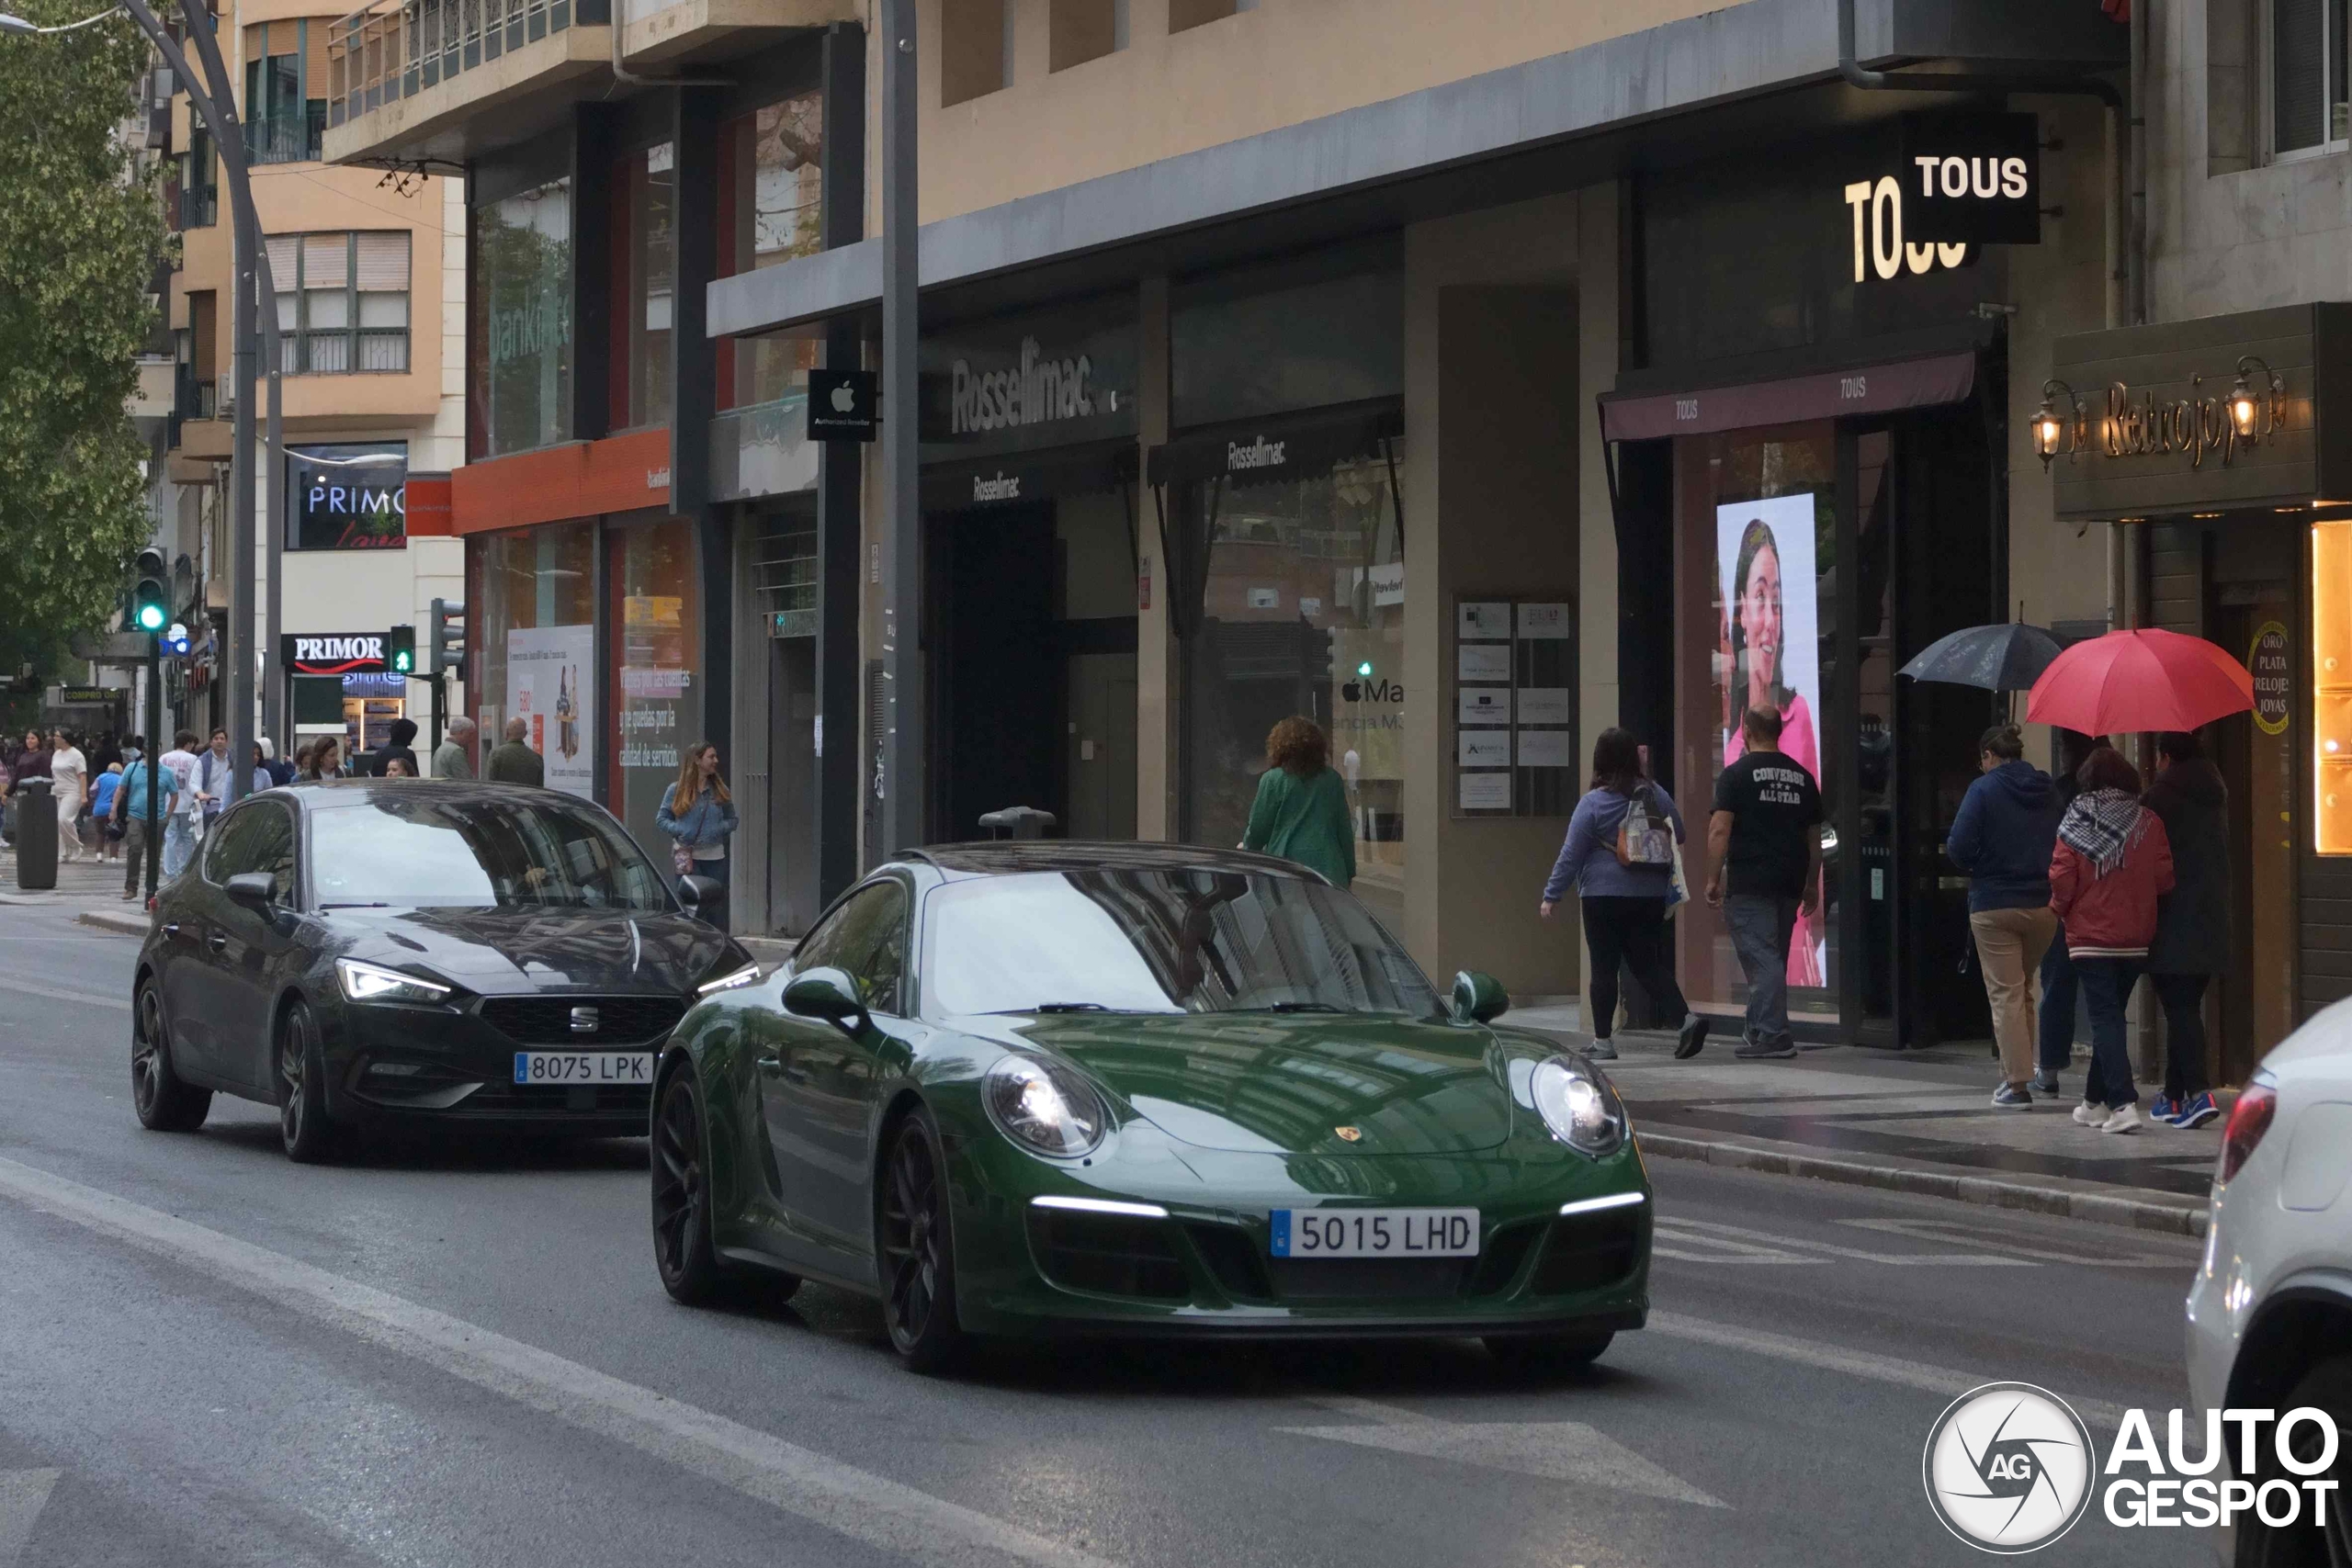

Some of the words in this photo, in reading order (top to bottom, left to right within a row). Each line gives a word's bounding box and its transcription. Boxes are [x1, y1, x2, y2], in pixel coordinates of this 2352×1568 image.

[1915, 156, 2028, 198] TOUS
[1845, 175, 1966, 283] TO
[1840, 376, 1866, 399] TOUS
[1676, 400, 1698, 420] TOUS
[814, 417, 846, 426] Authorized
[295, 637, 384, 660] PRIMOR
[2263, 635, 2283, 649] ORO
[2259, 656, 2287, 670] PLATA
[66, 689, 102, 700] COMPRO
[2259, 698, 2287, 715] JOYAS
[632, 704, 655, 734] quedas
[656, 709, 668, 734] por
[668, 702, 675, 728] la
[619, 742, 641, 767] calidad
[642, 742, 651, 767] de
[1752, 767, 1804, 786] CONVERSE
[1758, 789, 1777, 802] ALL
[1777, 791, 1801, 805] STAR
[532, 1056, 592, 1079] 8075
[601, 1056, 644, 1079] LPK
[1301, 1216, 1391, 1251] 5015
[1405, 1216, 1471, 1251] LHD
